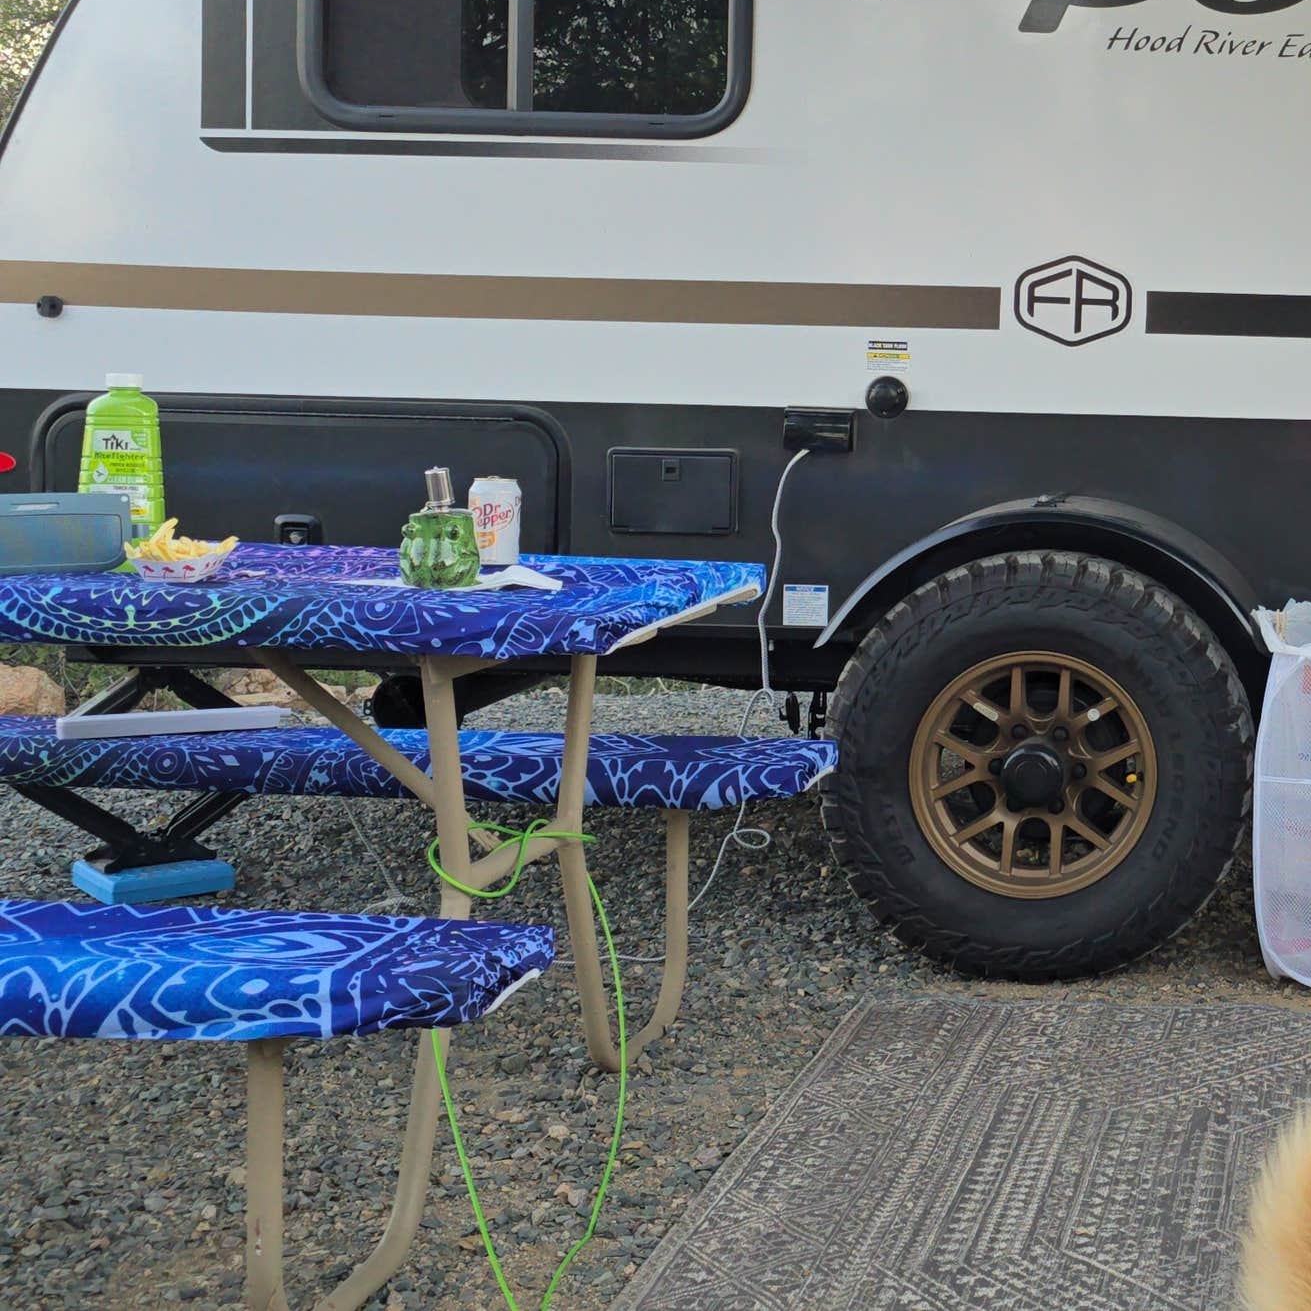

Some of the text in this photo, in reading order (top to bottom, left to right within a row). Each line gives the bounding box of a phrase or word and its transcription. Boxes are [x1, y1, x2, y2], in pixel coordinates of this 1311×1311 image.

[1106, 26, 1186, 56] Hood
[1194, 29, 1271, 58] River
[483, 503, 501, 517] Dr
